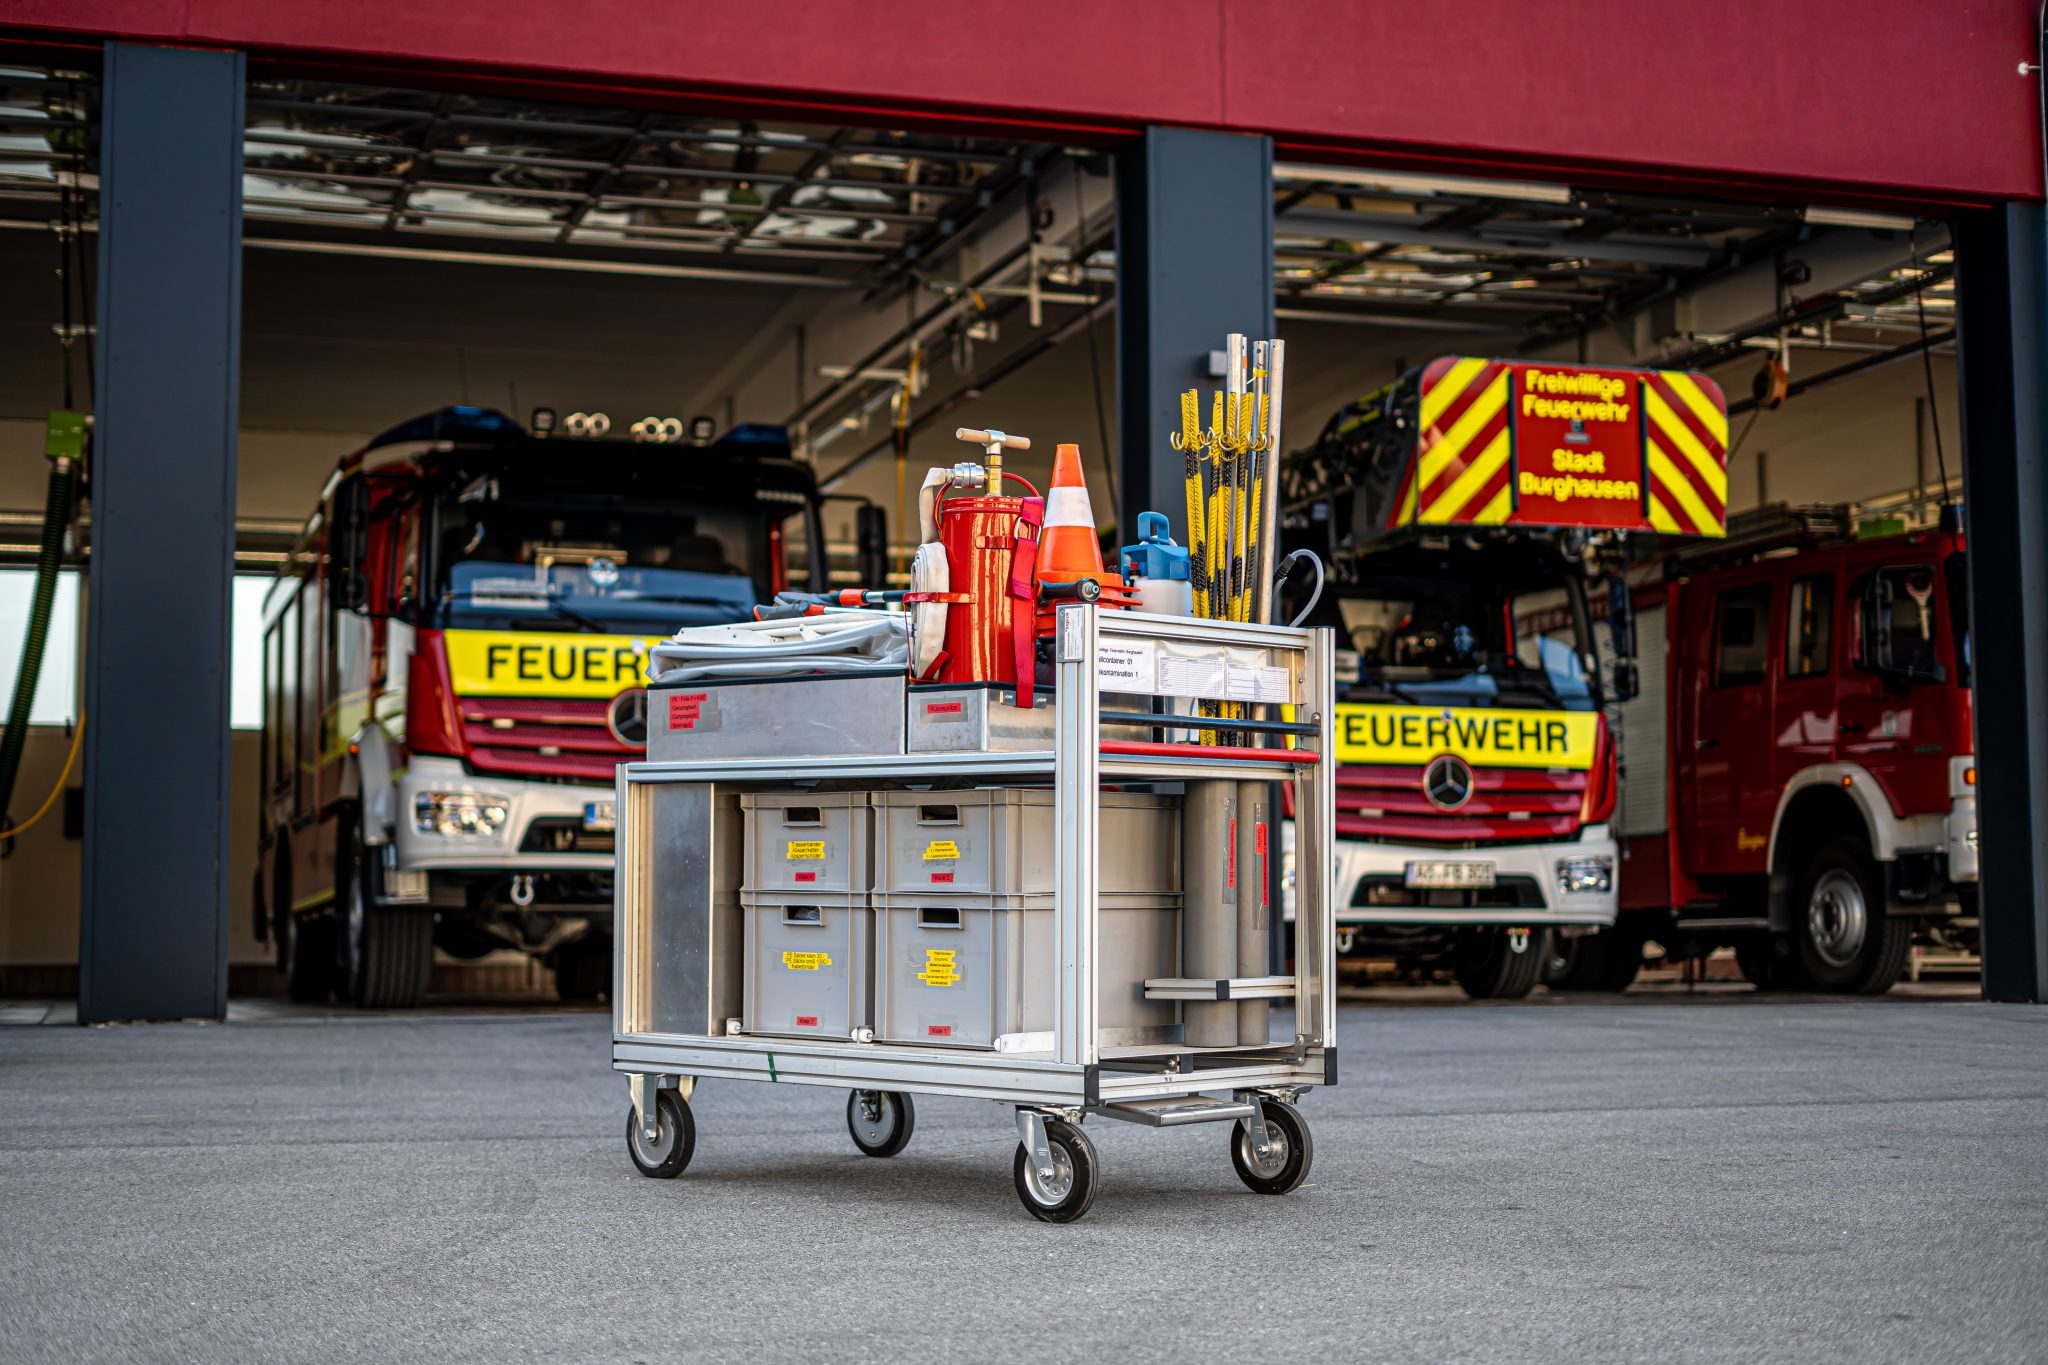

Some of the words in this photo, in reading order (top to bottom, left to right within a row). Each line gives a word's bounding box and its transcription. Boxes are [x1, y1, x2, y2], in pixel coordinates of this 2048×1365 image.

[1525, 369, 1626, 401] Freiwillige
[1522, 394, 1631, 423] Feuerwehr
[1551, 448, 1606, 474] Stadt
[1518, 472, 1639, 502] Burghausen
[486, 643, 651, 682] FEUER
[1099, 669, 1134, 678] kontamination
[1335, 711, 1569, 754] EUERWEHR
